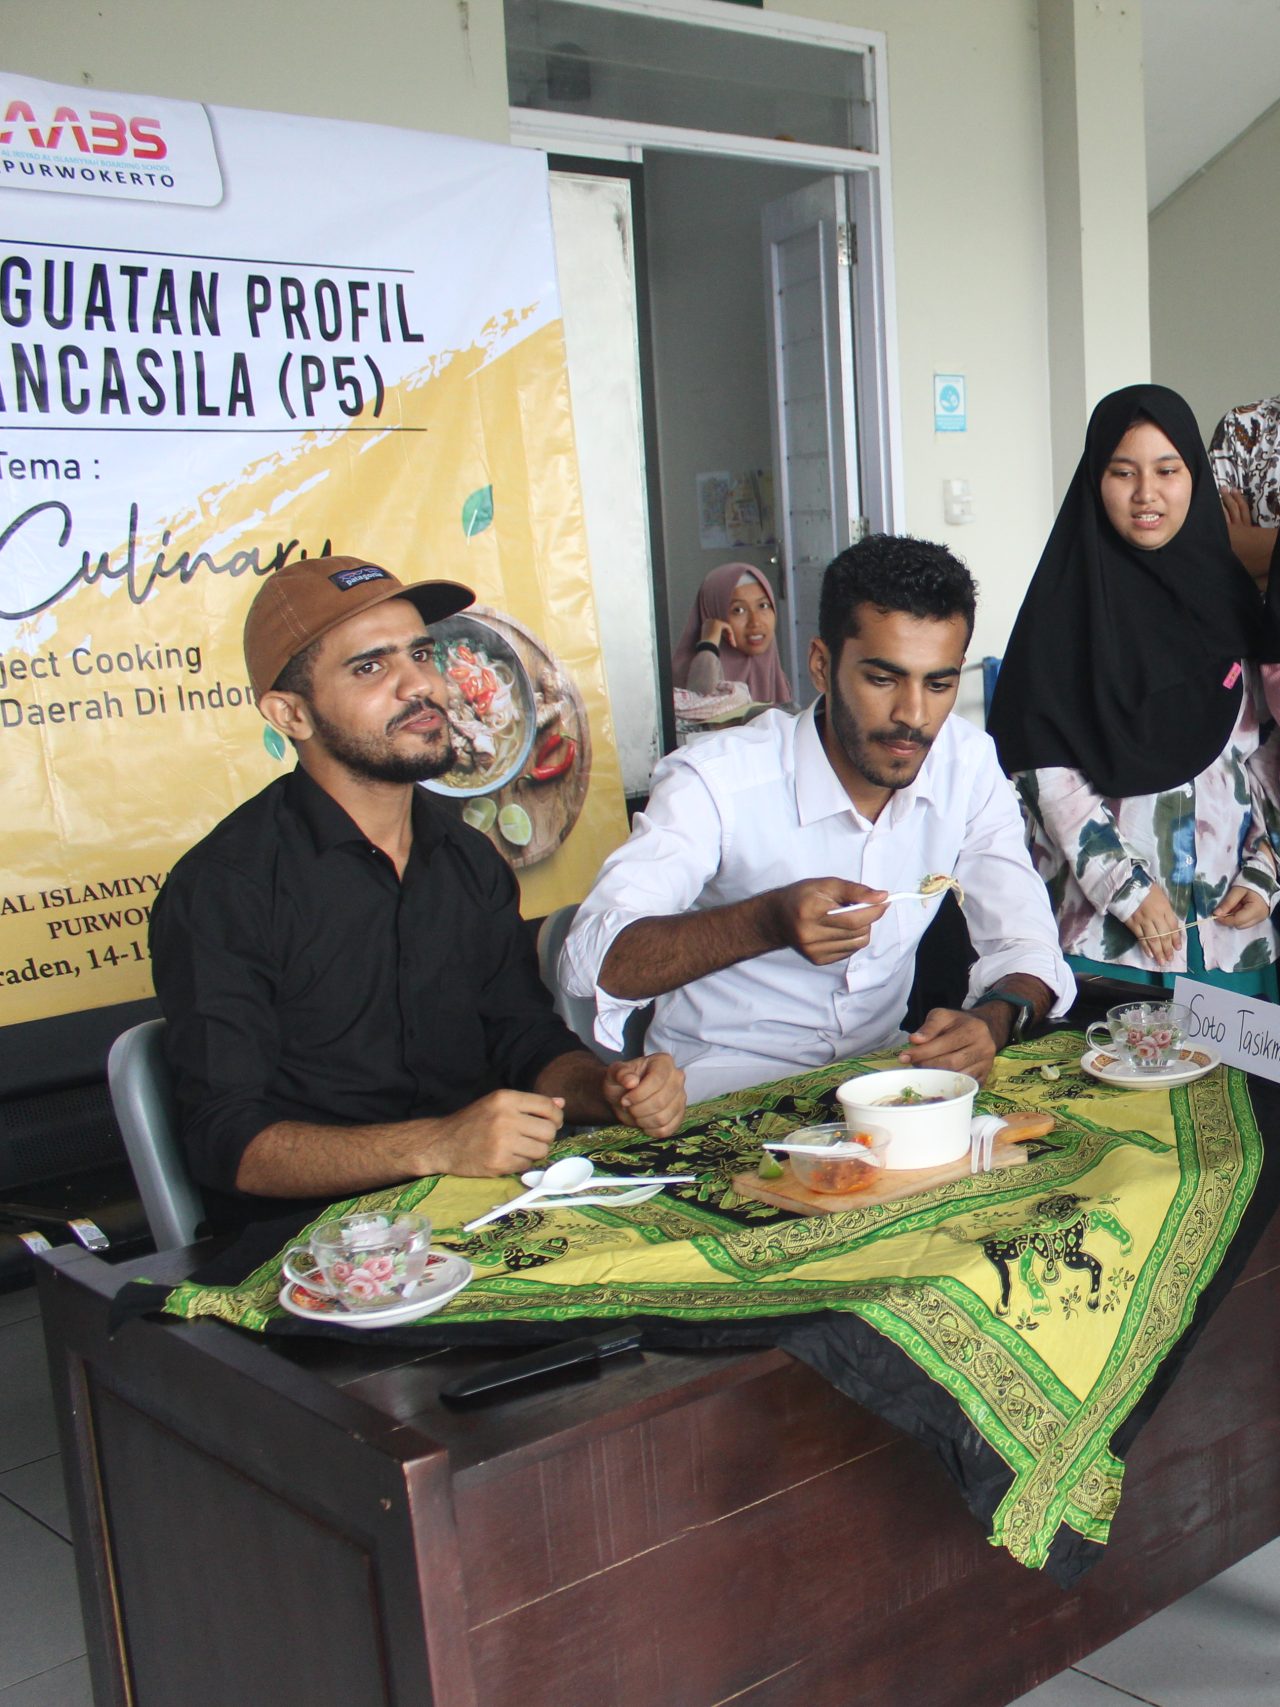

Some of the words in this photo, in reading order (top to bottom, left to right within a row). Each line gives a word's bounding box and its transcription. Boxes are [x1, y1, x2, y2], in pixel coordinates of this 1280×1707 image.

[2, 160, 175, 188] PURWOKERTO
[0, 256, 221, 337] GUATAN
[247, 273, 425, 343] PROFIL
[0, 342, 256, 418] NCASILA
[278, 351, 385, 419] (P5)
[0, 500, 332, 621] Culinar
[72, 643, 203, 674] Cooking
[0, 690, 124, 728] Daerah
[134, 686, 167, 716] Di
[1, 894, 35, 915] AL
[1189, 993, 1226, 1043] Soto
